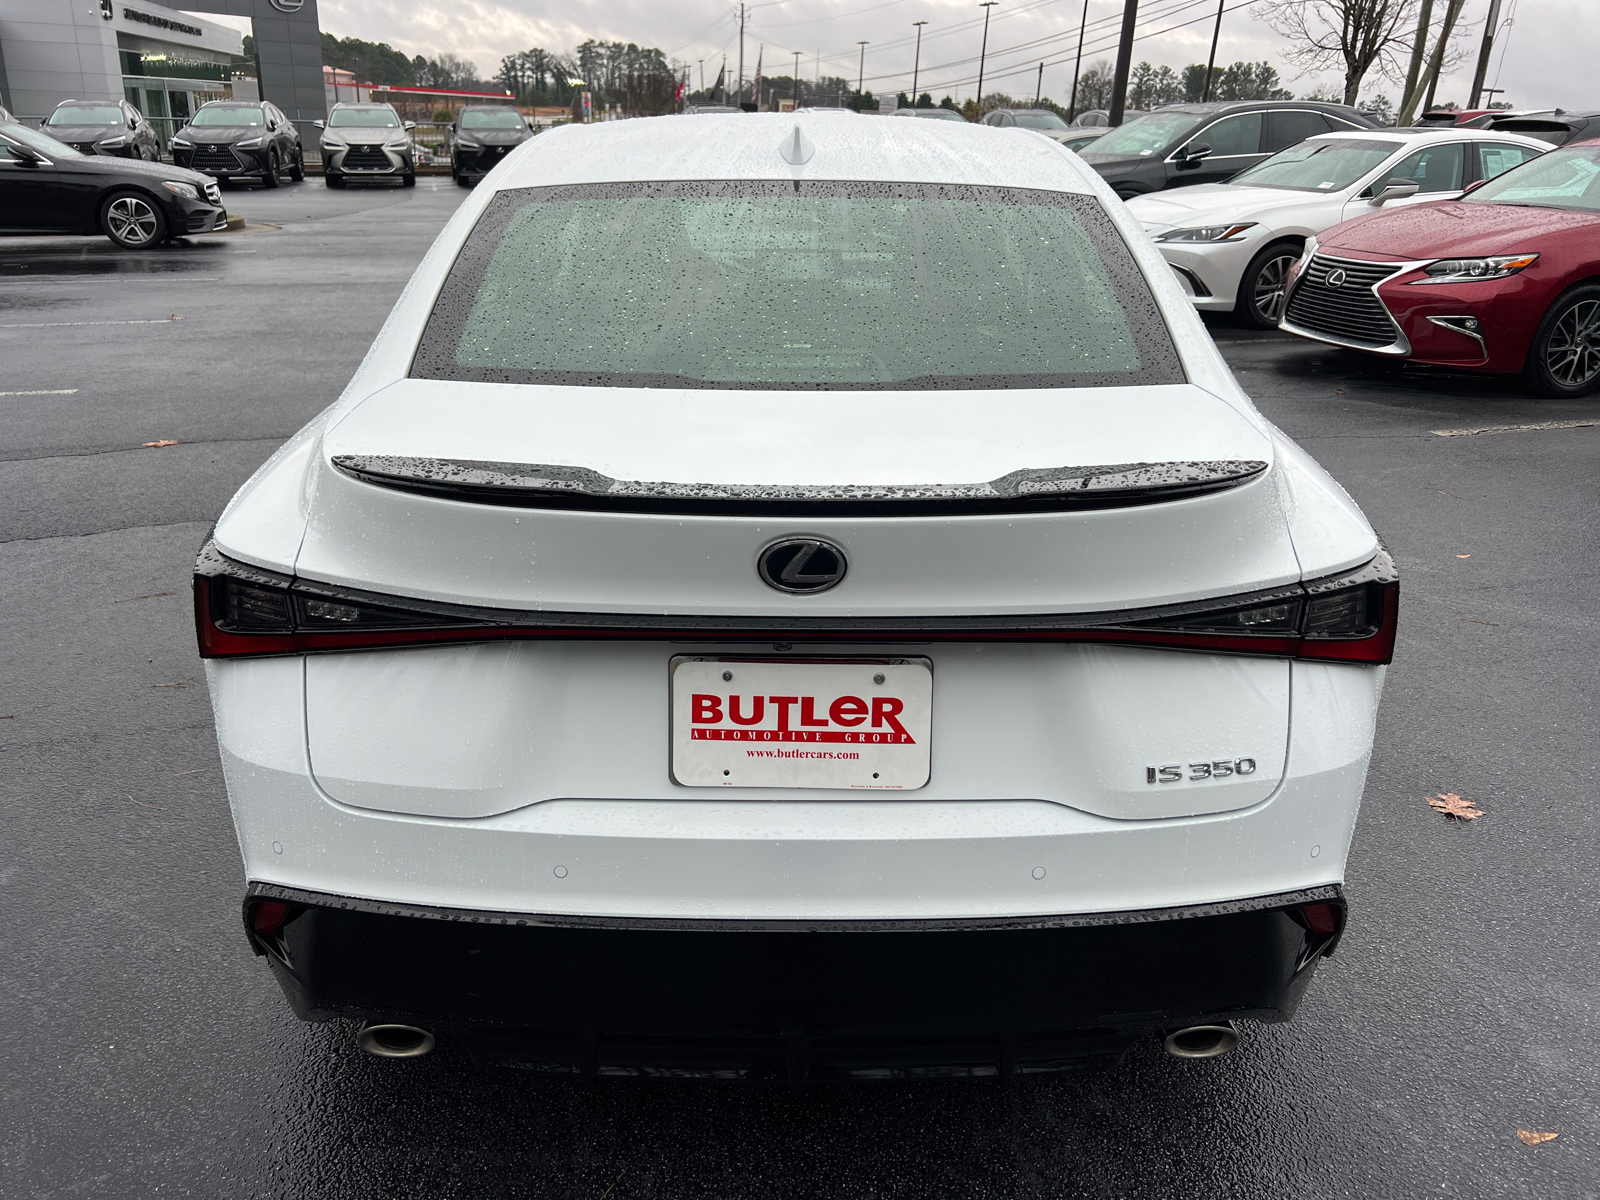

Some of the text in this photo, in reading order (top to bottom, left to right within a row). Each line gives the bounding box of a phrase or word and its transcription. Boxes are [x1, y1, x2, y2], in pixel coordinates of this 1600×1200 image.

[692, 729, 908, 744] AUTOMOTIVE GROUP
[746, 749, 860, 760] www.butlercars.com
[1146, 757, 1256, 784] IS 350
